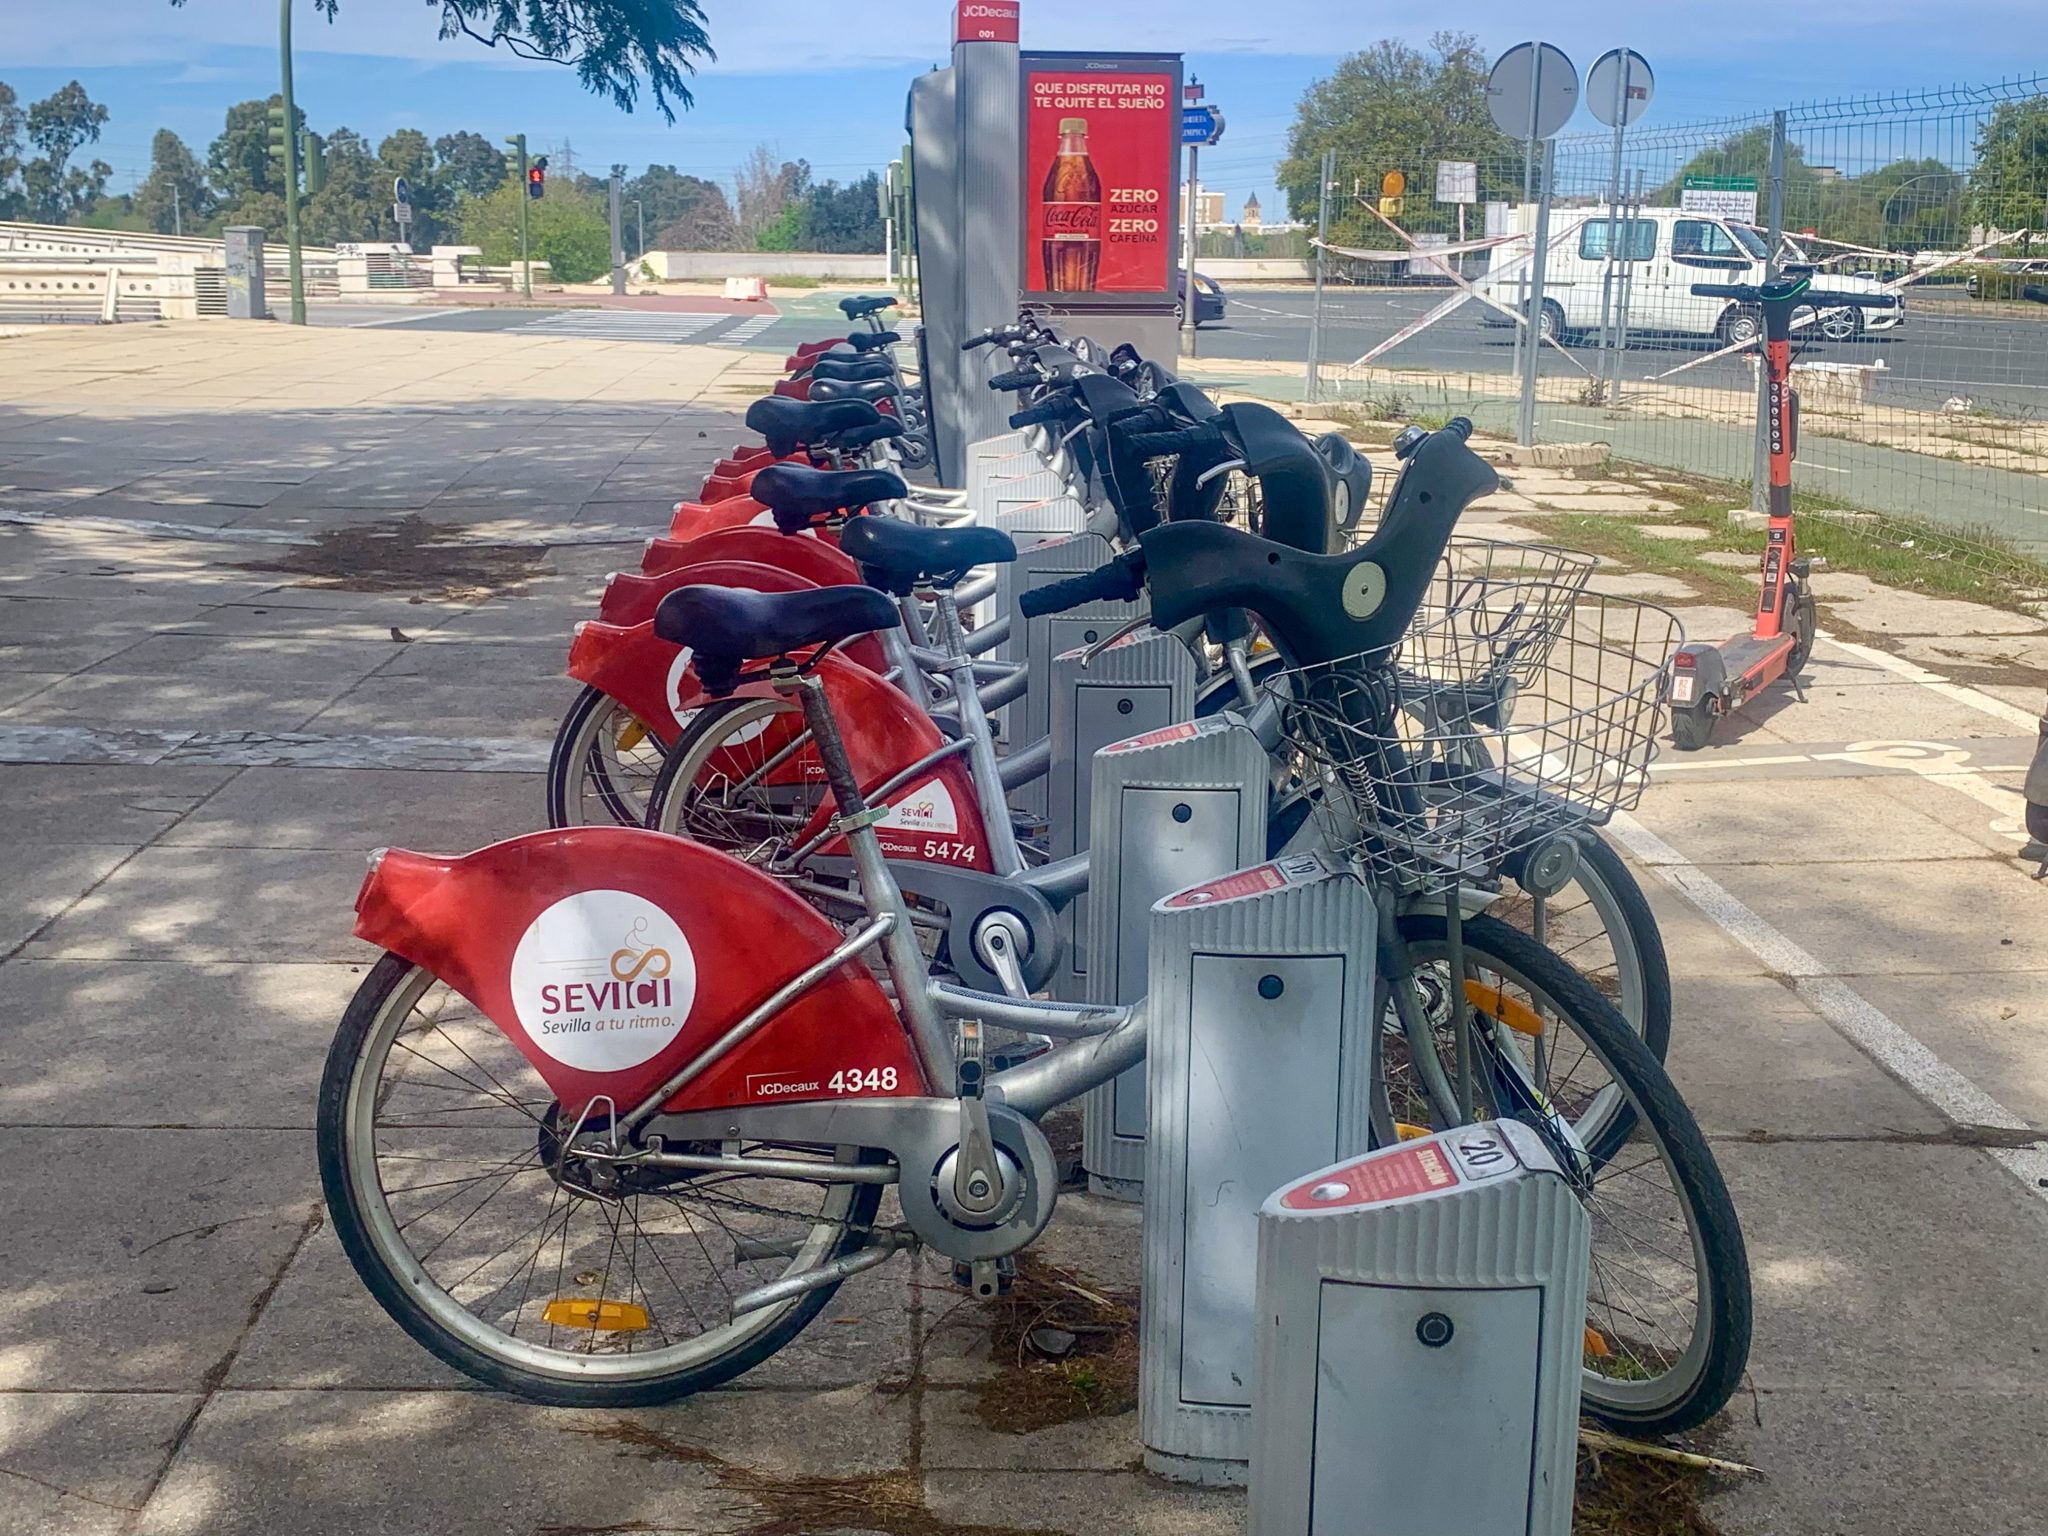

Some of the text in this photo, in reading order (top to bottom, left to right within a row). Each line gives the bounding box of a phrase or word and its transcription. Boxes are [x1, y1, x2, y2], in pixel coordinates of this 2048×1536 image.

[963, 5, 1018, 18] JCDecau
[978, 30, 995, 38] 001
[1034, 83, 1165, 95] QUE DISFRUTAR NO
[1034, 96, 1165, 109] TE QUITE EL SUEÑO
[1109, 189, 1159, 203] ZERO
[1111, 203, 1158, 214] AZÚCAR
[1046, 205, 1098, 227] Coca-Cola
[1109, 219, 1158, 232] ZERO
[1109, 233, 1158, 243] CAFEÍNA
[924, 840, 975, 862] 5474
[542, 1015, 675, 1034] Sevilla a tu ritmo.
[757, 1067, 898, 1096] JCDecaux 4348
[1459, 1140, 1504, 1166] 20
